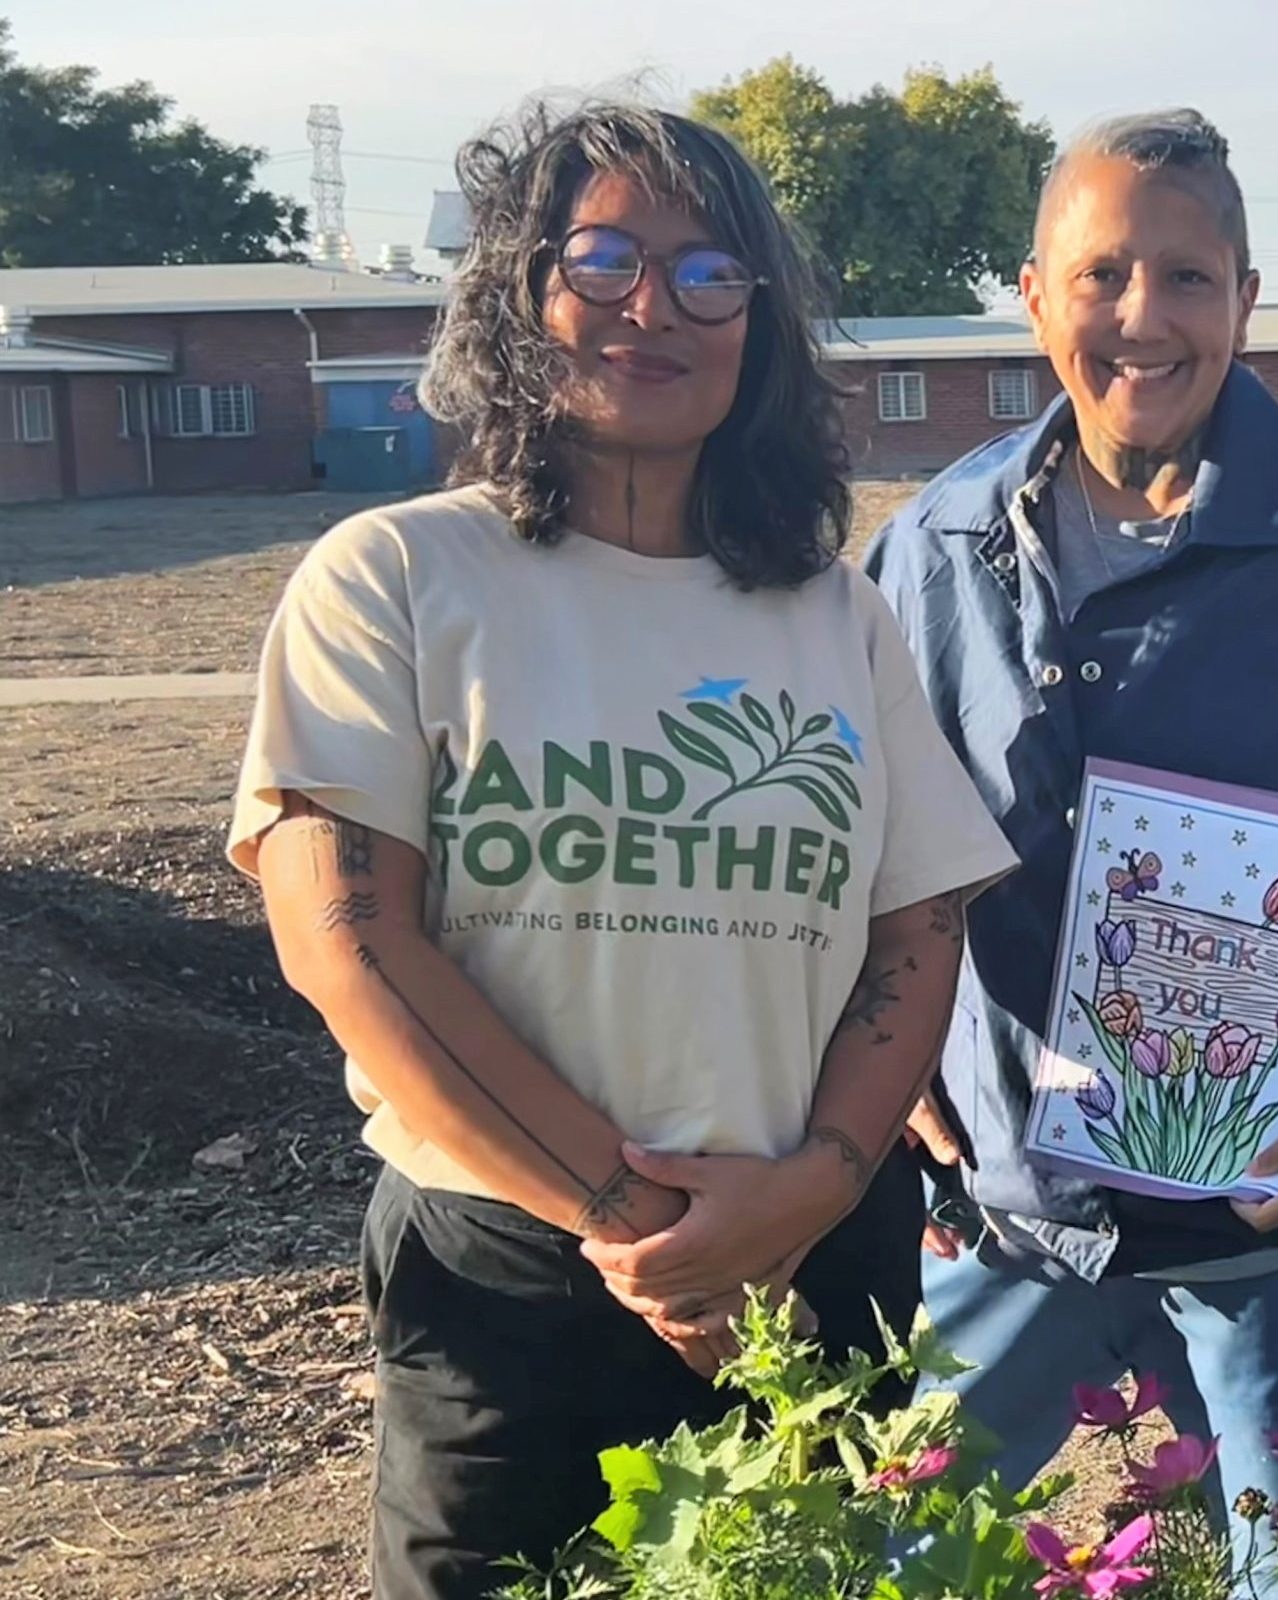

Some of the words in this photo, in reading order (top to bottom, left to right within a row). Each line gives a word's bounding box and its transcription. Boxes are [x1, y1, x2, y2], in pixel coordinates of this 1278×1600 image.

[441, 911, 563, 933] ULTIVATING
[575, 911, 719, 936] BELONGING
[727, 920, 777, 939] AND
[1151, 917, 1258, 972] Thank
[1155, 983, 1222, 1020] you
